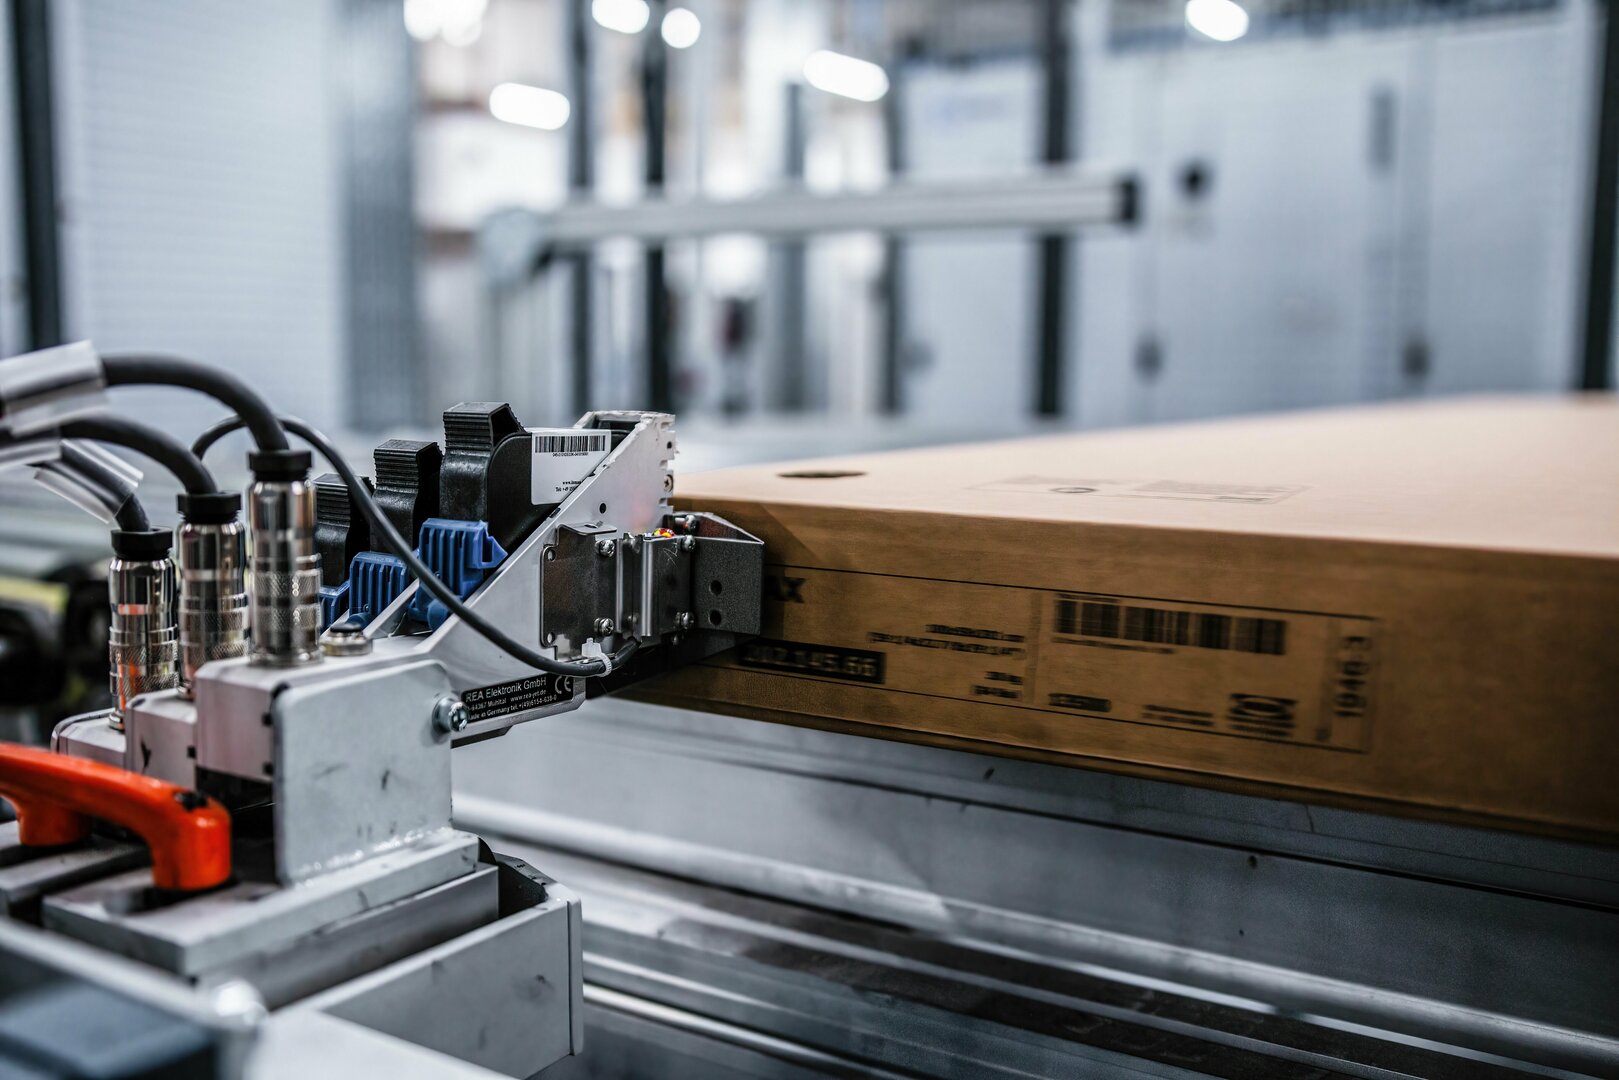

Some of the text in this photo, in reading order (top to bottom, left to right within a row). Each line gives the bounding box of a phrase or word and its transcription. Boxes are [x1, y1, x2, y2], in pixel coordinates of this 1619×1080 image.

[465, 676, 547, 703] REA Elektronik GmbH
[487, 705, 510, 717] Germany
